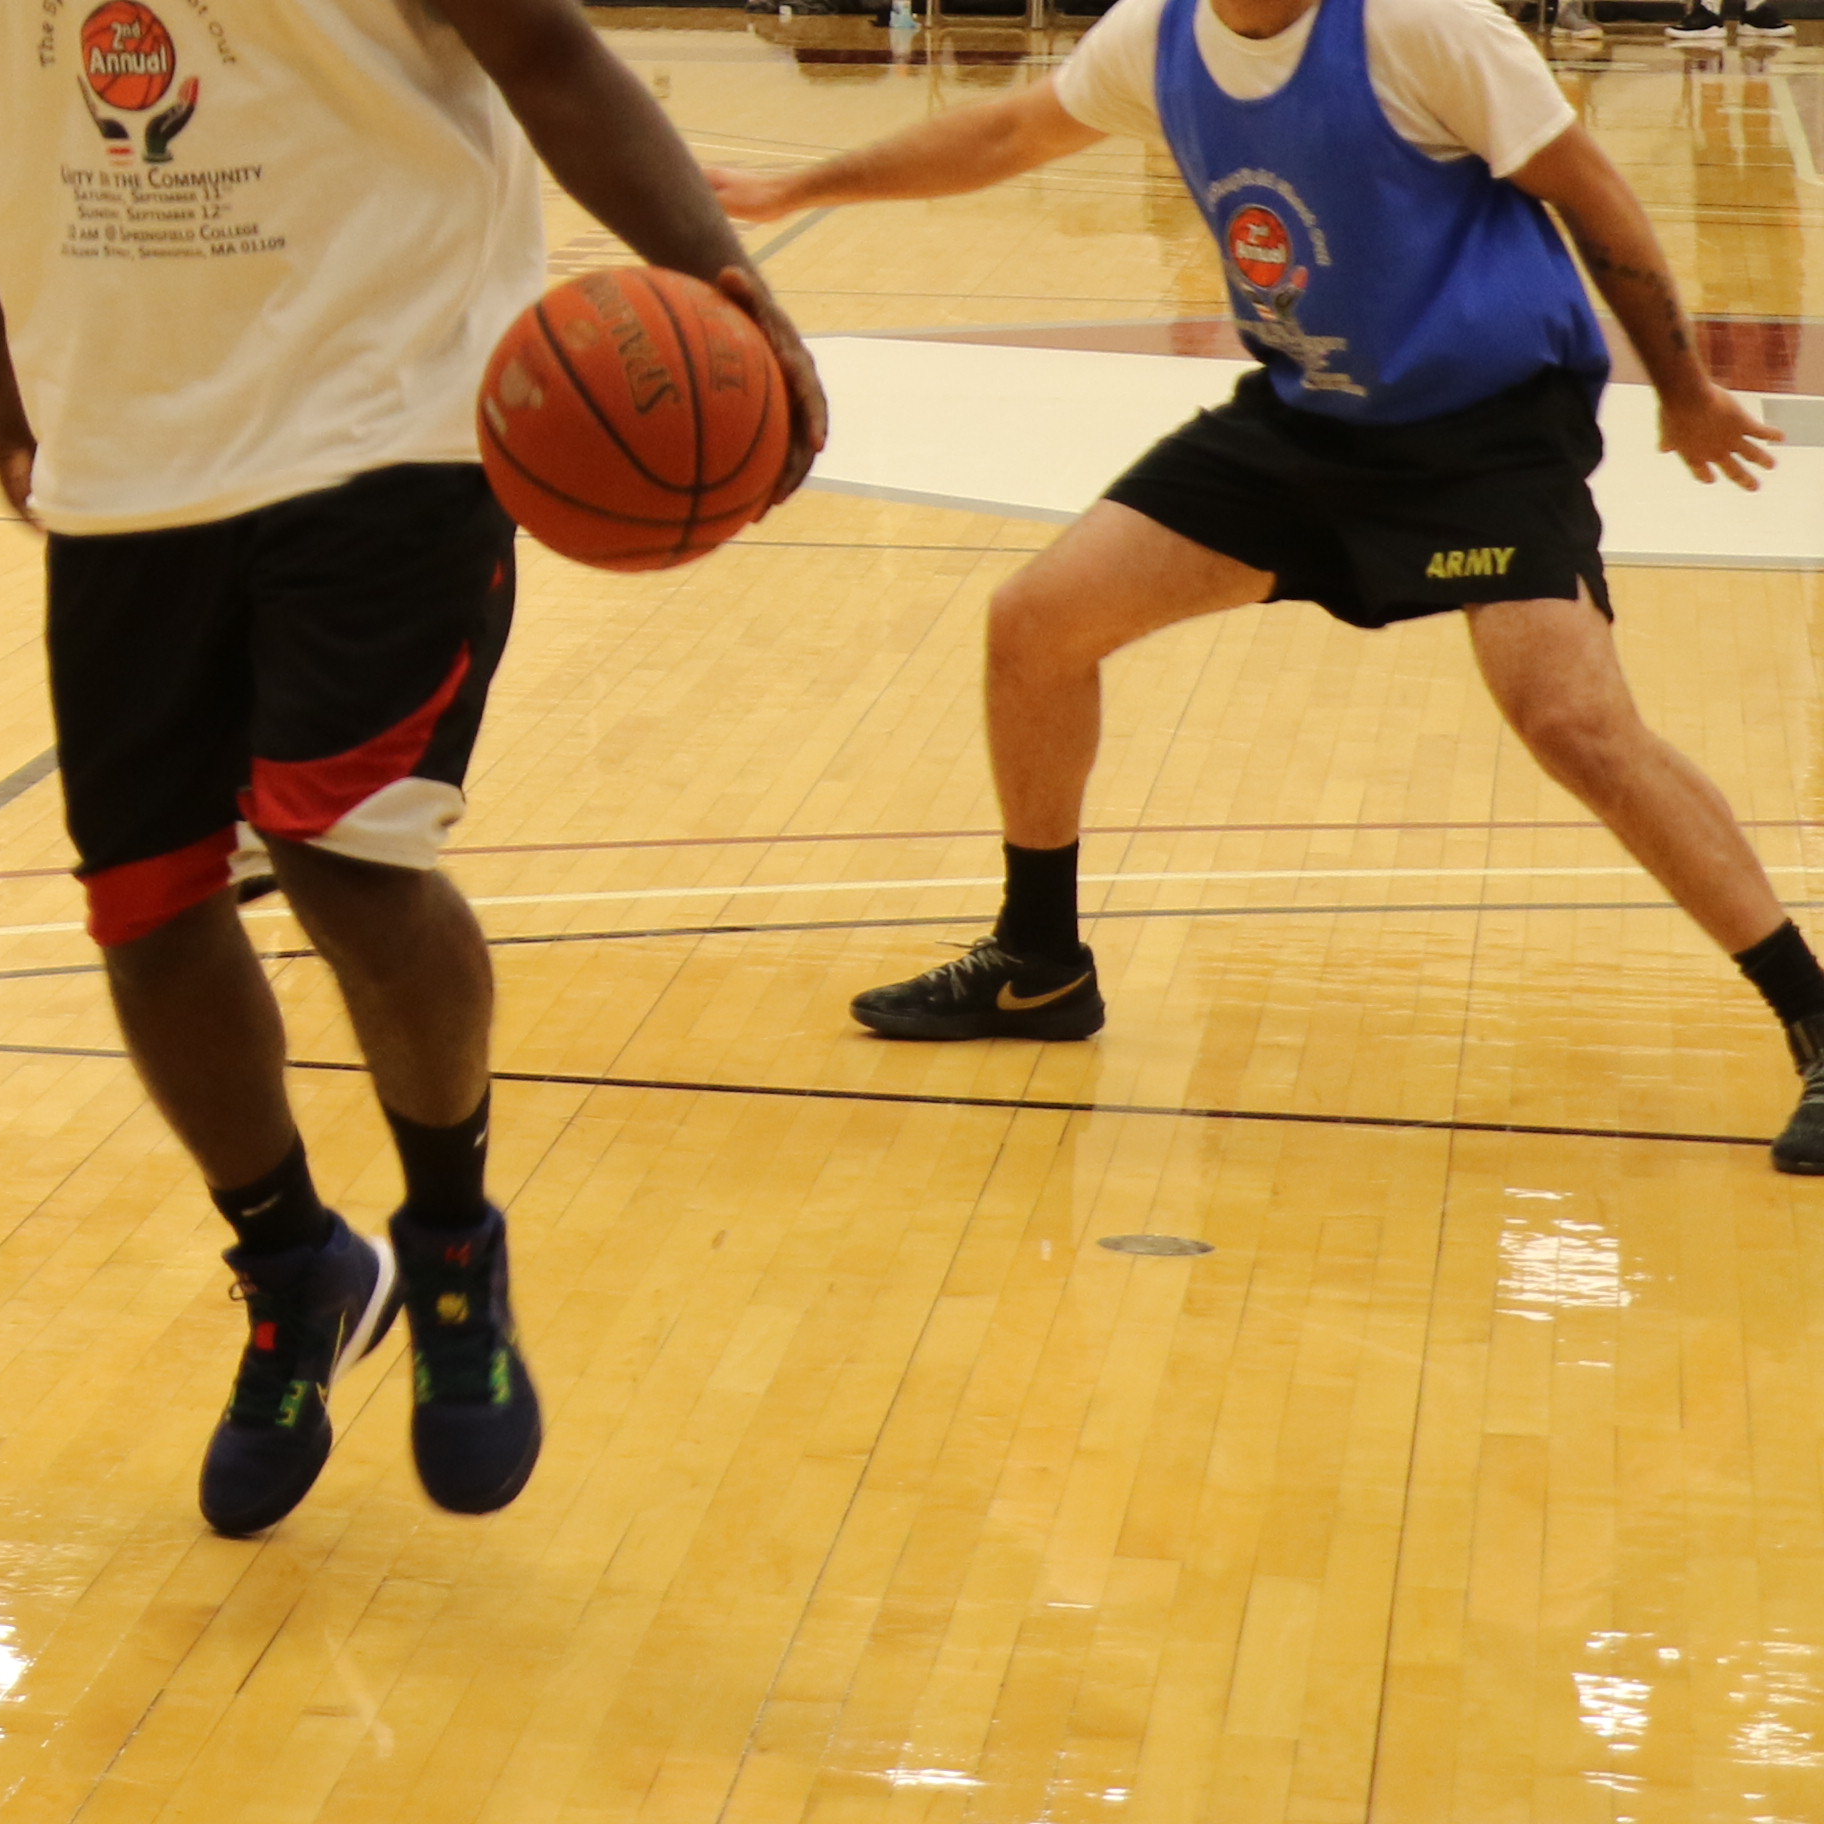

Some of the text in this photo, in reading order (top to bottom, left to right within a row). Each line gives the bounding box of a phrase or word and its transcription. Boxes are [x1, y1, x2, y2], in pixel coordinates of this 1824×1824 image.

[38, 21, 56, 69] The
[209, 21, 238, 65] Out
[110, 20, 142, 51] 2nd
[90, 45, 168, 75] Annual
[1424, 546, 1516, 579] ARMY
